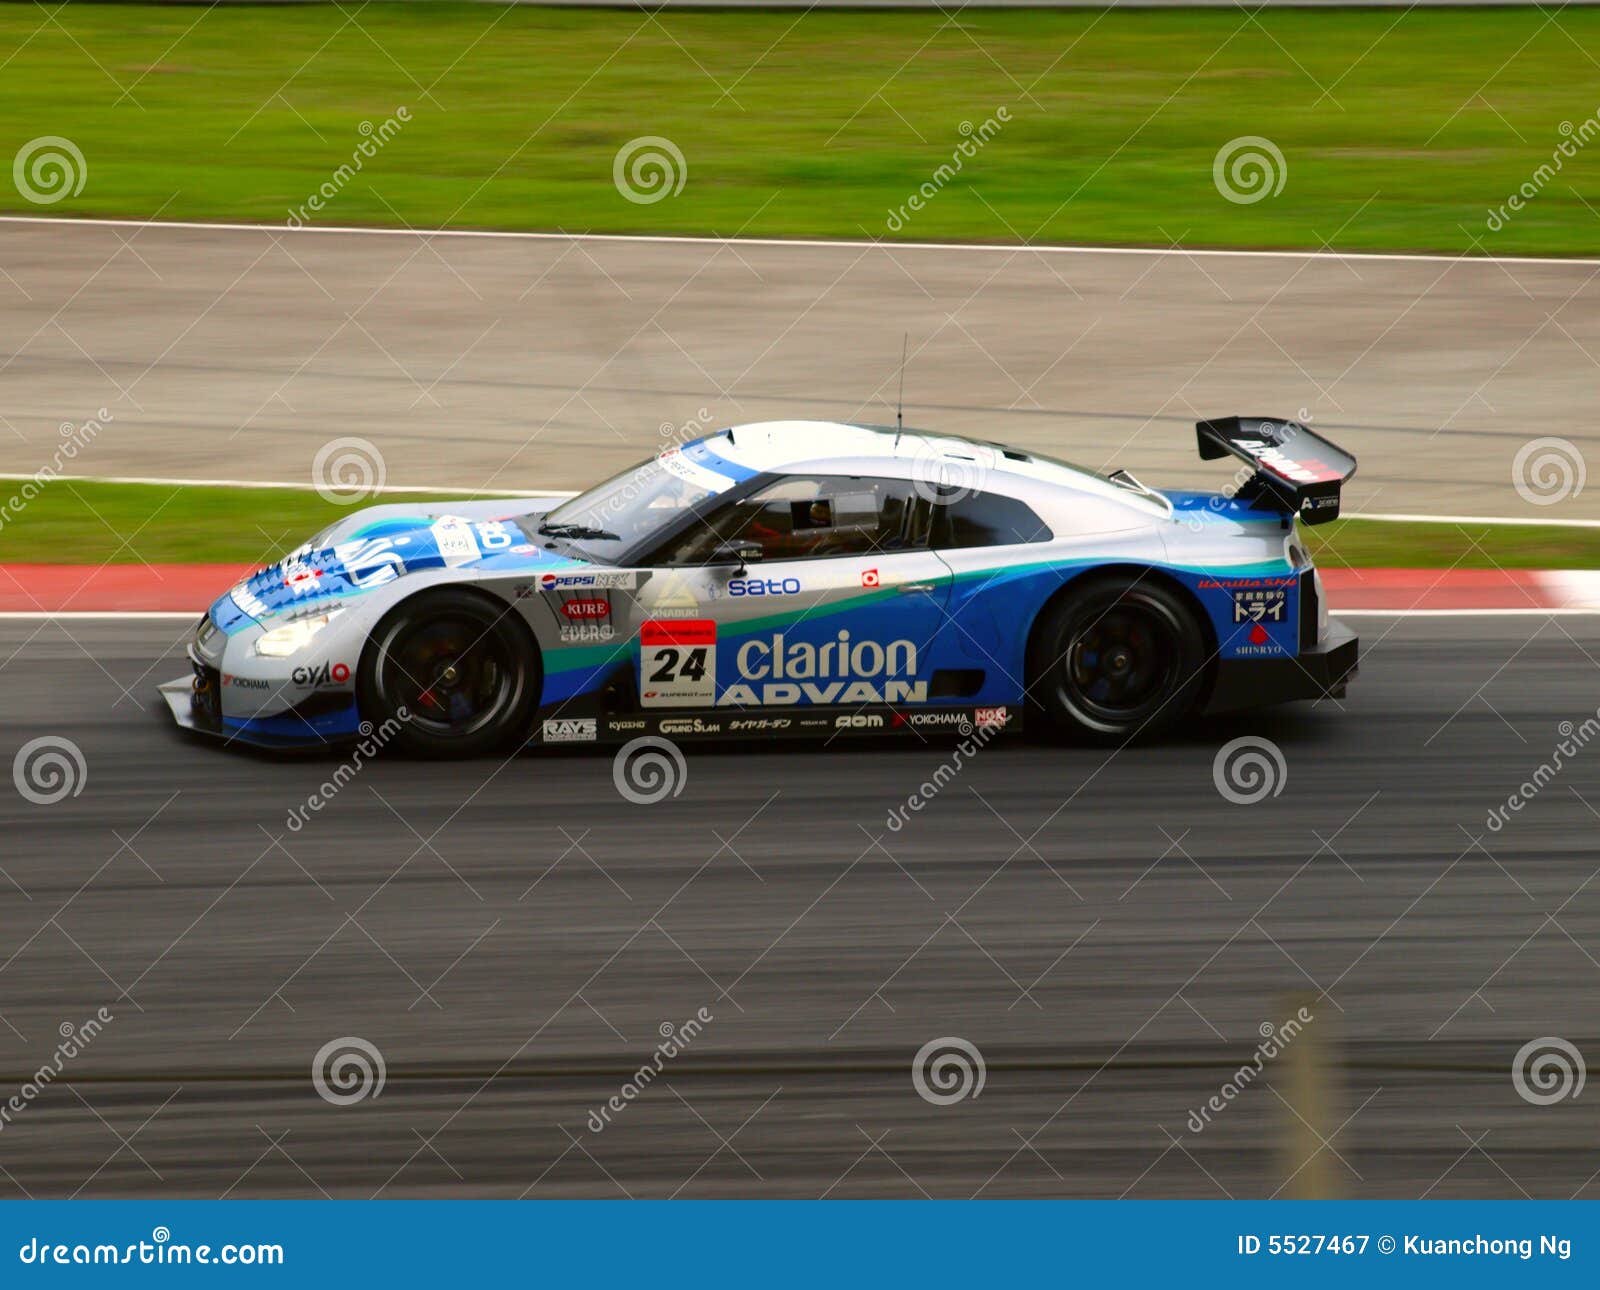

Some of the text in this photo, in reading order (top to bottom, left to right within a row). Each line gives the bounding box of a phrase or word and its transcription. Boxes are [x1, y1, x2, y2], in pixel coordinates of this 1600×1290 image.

[555, 576, 595, 586] PEPSI
[728, 578, 801, 597] sato
[567, 602, 606, 615] KURE
[1235, 601, 1285, 622] トライ
[1235, 645, 1282, 655] SHINRYO
[649, 647, 708, 682] 24
[714, 680, 929, 706] ADVAN
[909, 713, 969, 725] YOKOHAMA
[543, 721, 597, 737] RAYS
